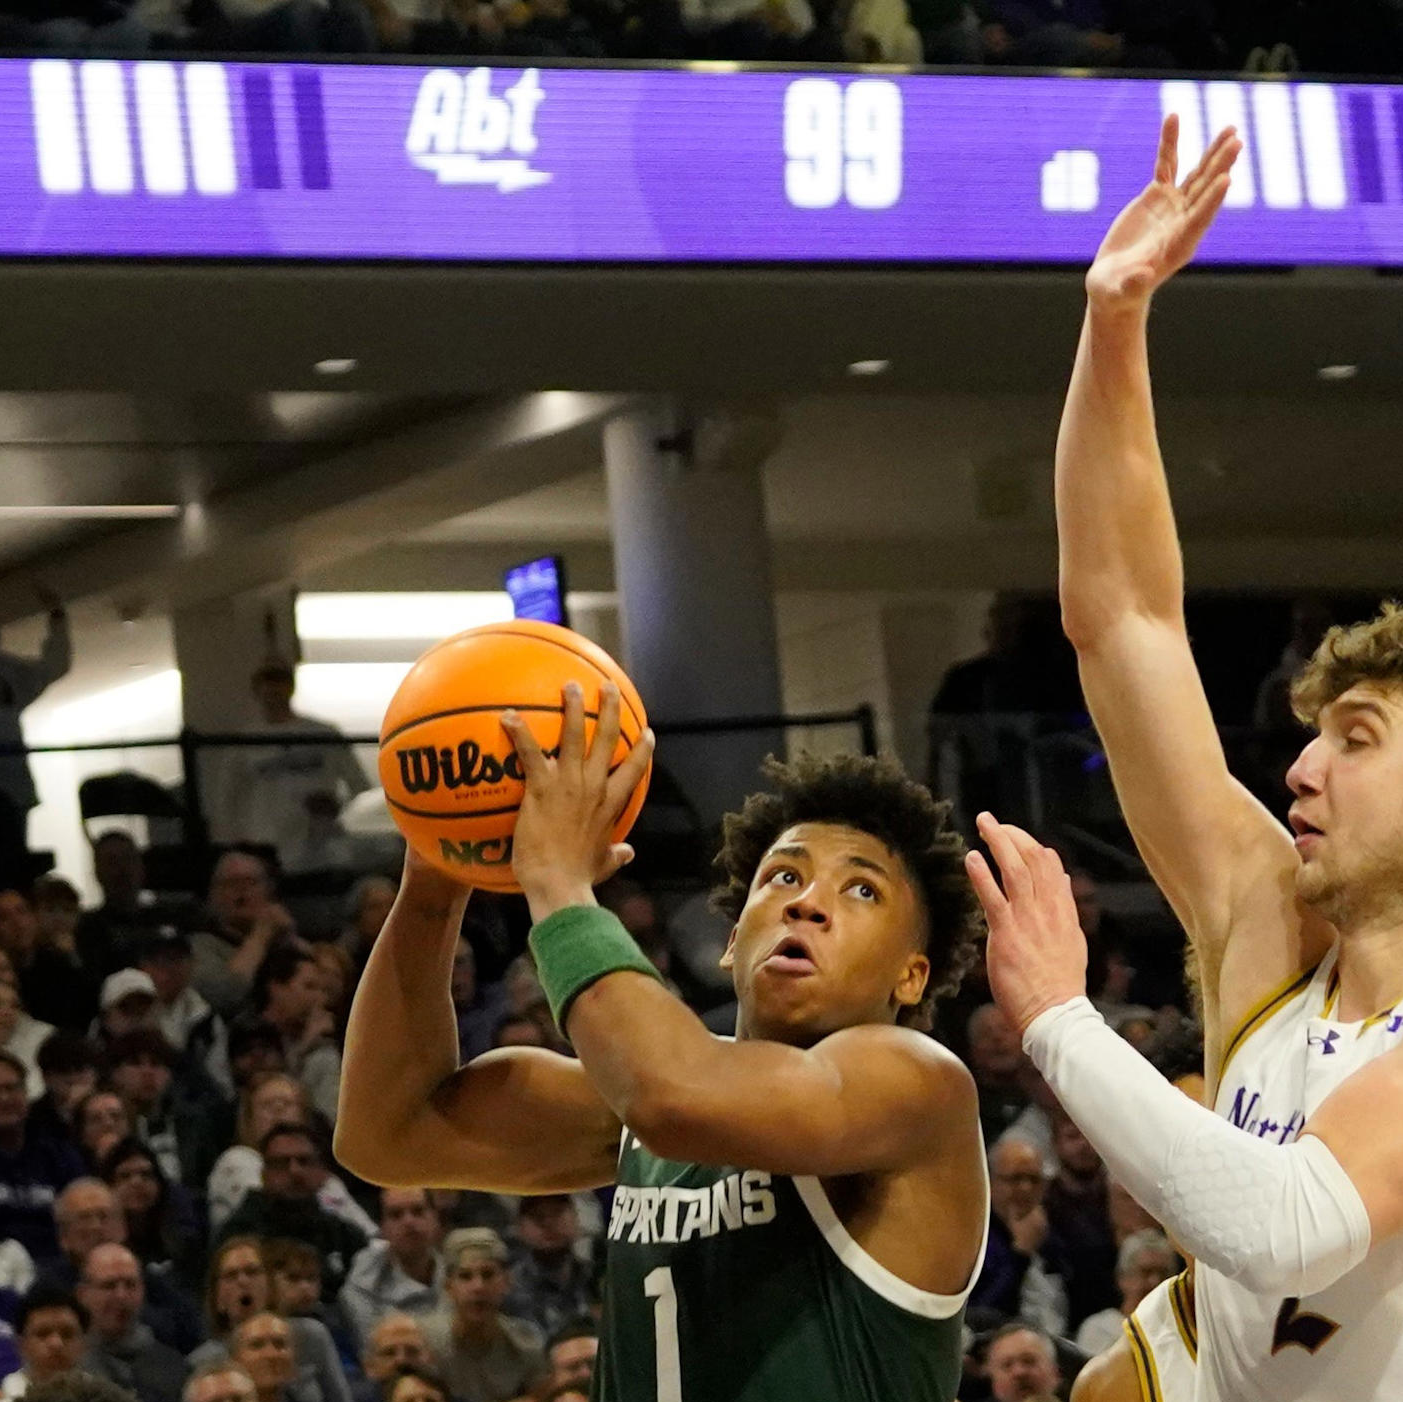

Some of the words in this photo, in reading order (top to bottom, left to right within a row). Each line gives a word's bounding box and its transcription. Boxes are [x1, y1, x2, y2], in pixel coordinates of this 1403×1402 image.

[406, 66, 546, 155] Abt
[783, 78, 903, 209] 99
[607, 1169, 777, 1244] SPARTANS
